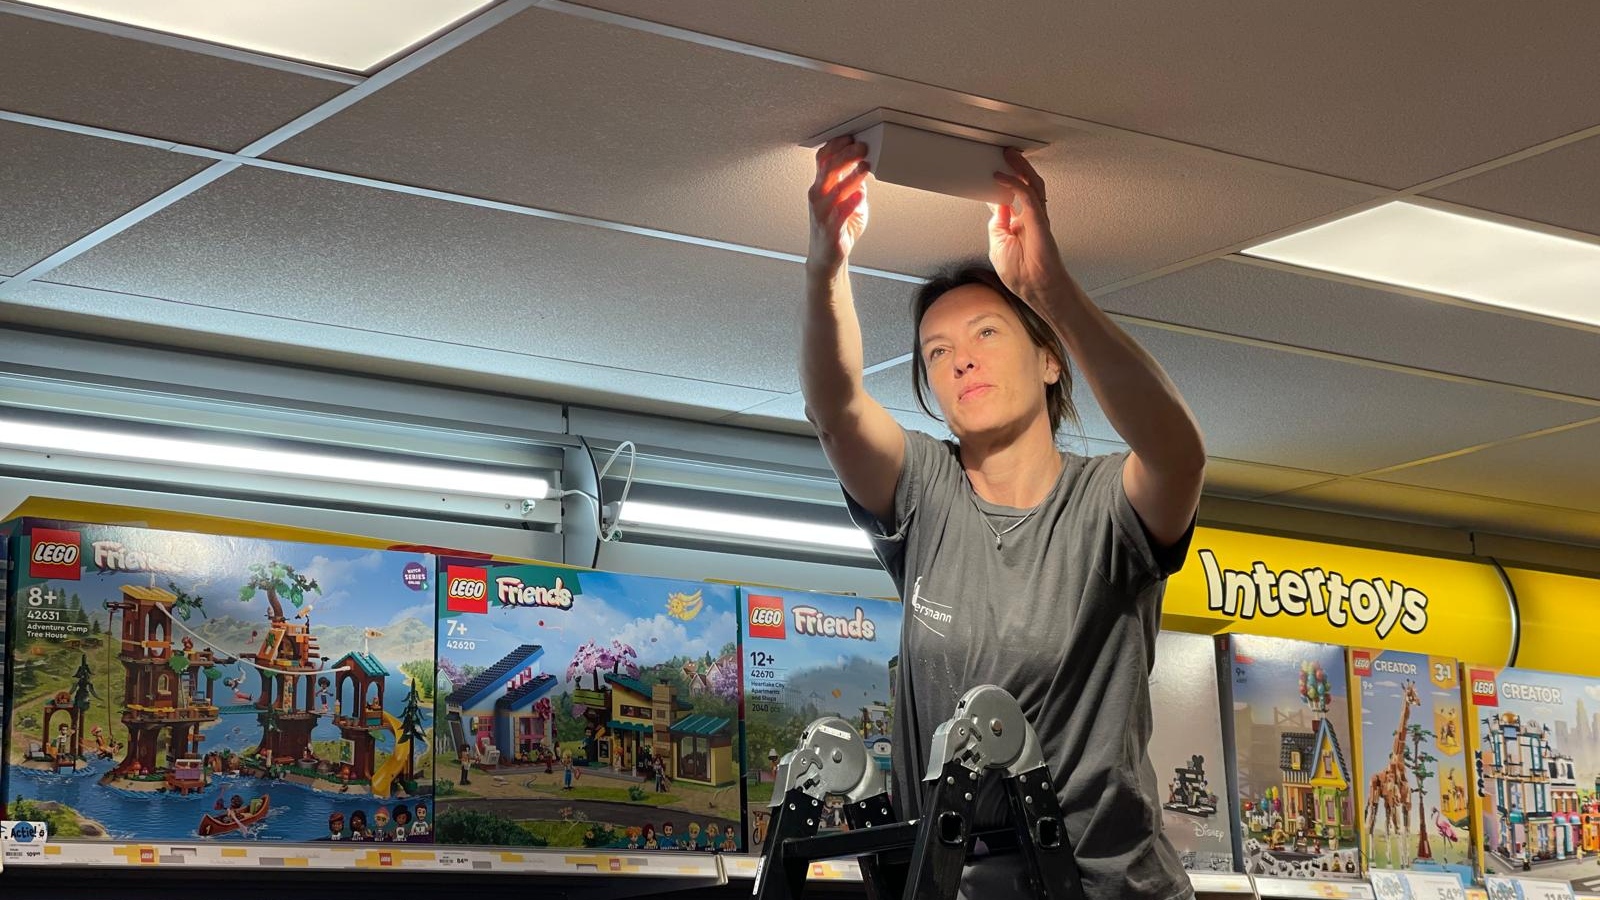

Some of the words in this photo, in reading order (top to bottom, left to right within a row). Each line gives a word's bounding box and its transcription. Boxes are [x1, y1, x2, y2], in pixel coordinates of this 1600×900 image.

[33, 543, 79, 565] LEGO
[28, 587, 57, 606] 8+
[450, 579, 485, 599] LEGO
[496, 576, 573, 610] Friends
[1198, 549, 1428, 639] Intertoys
[27, 610, 60, 620] 42631
[751, 607, 783, 626] LEGO
[791, 605, 876, 641] Friends
[27, 623, 65, 631] Adventure
[67, 625, 88, 633] Camp
[447, 620, 468, 637] 7+
[447, 641, 475, 651] 42620
[750, 651, 775, 667] 12+
[1354, 658, 1370, 670] LEGO
[1374, 660, 1417, 675] CREATOR
[751, 670, 774, 679] 42670
[775, 682, 785, 690] City
[1473, 680, 1495, 696] LEGO
[1502, 682, 1562, 705] CREATOR
[752, 703, 769, 712] 2040
[11, 825, 37, 839] Actie!
